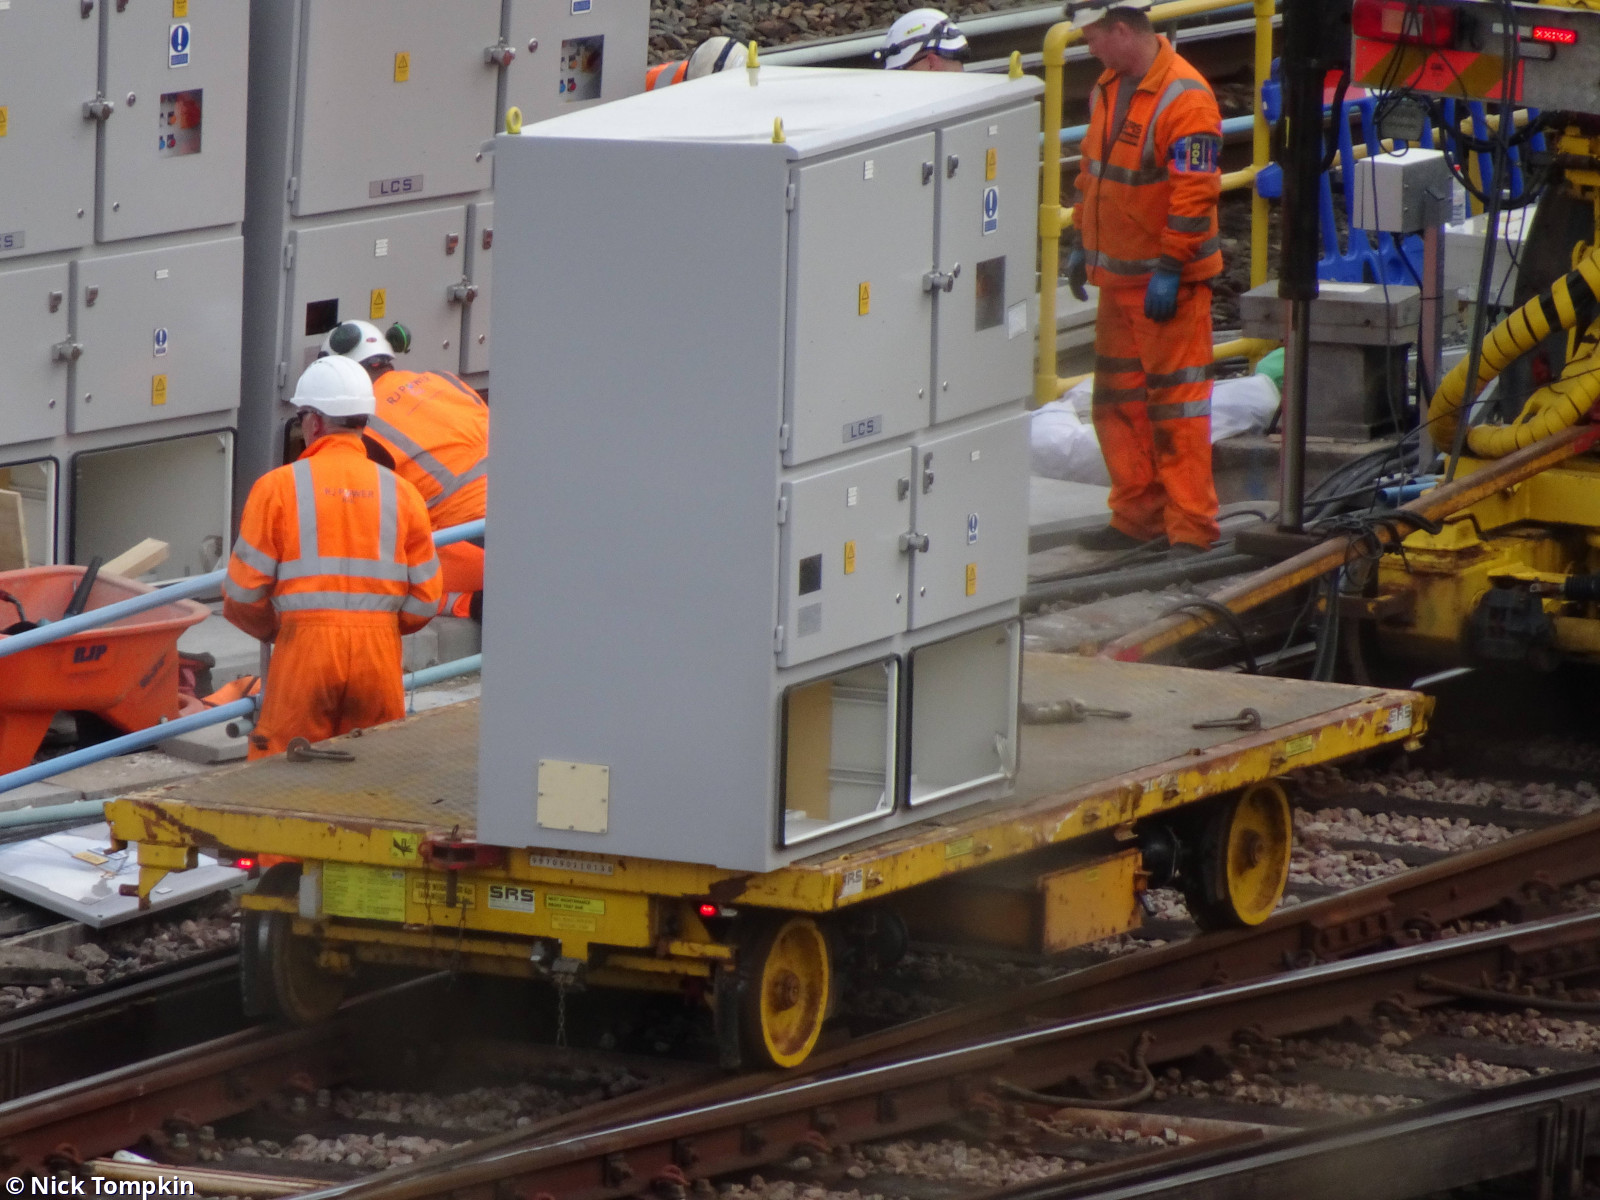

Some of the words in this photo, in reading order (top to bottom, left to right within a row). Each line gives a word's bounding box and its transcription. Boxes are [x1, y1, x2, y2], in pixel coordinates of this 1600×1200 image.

[1191, 142, 1201, 165] POS
[381, 178, 412, 195] LCS
[0, 235, 14, 248] S
[851, 420, 874, 438] LCS
[1388, 705, 1411, 723] SRS
[843, 869, 863, 886] RS
[489, 885, 534, 902] SRS
